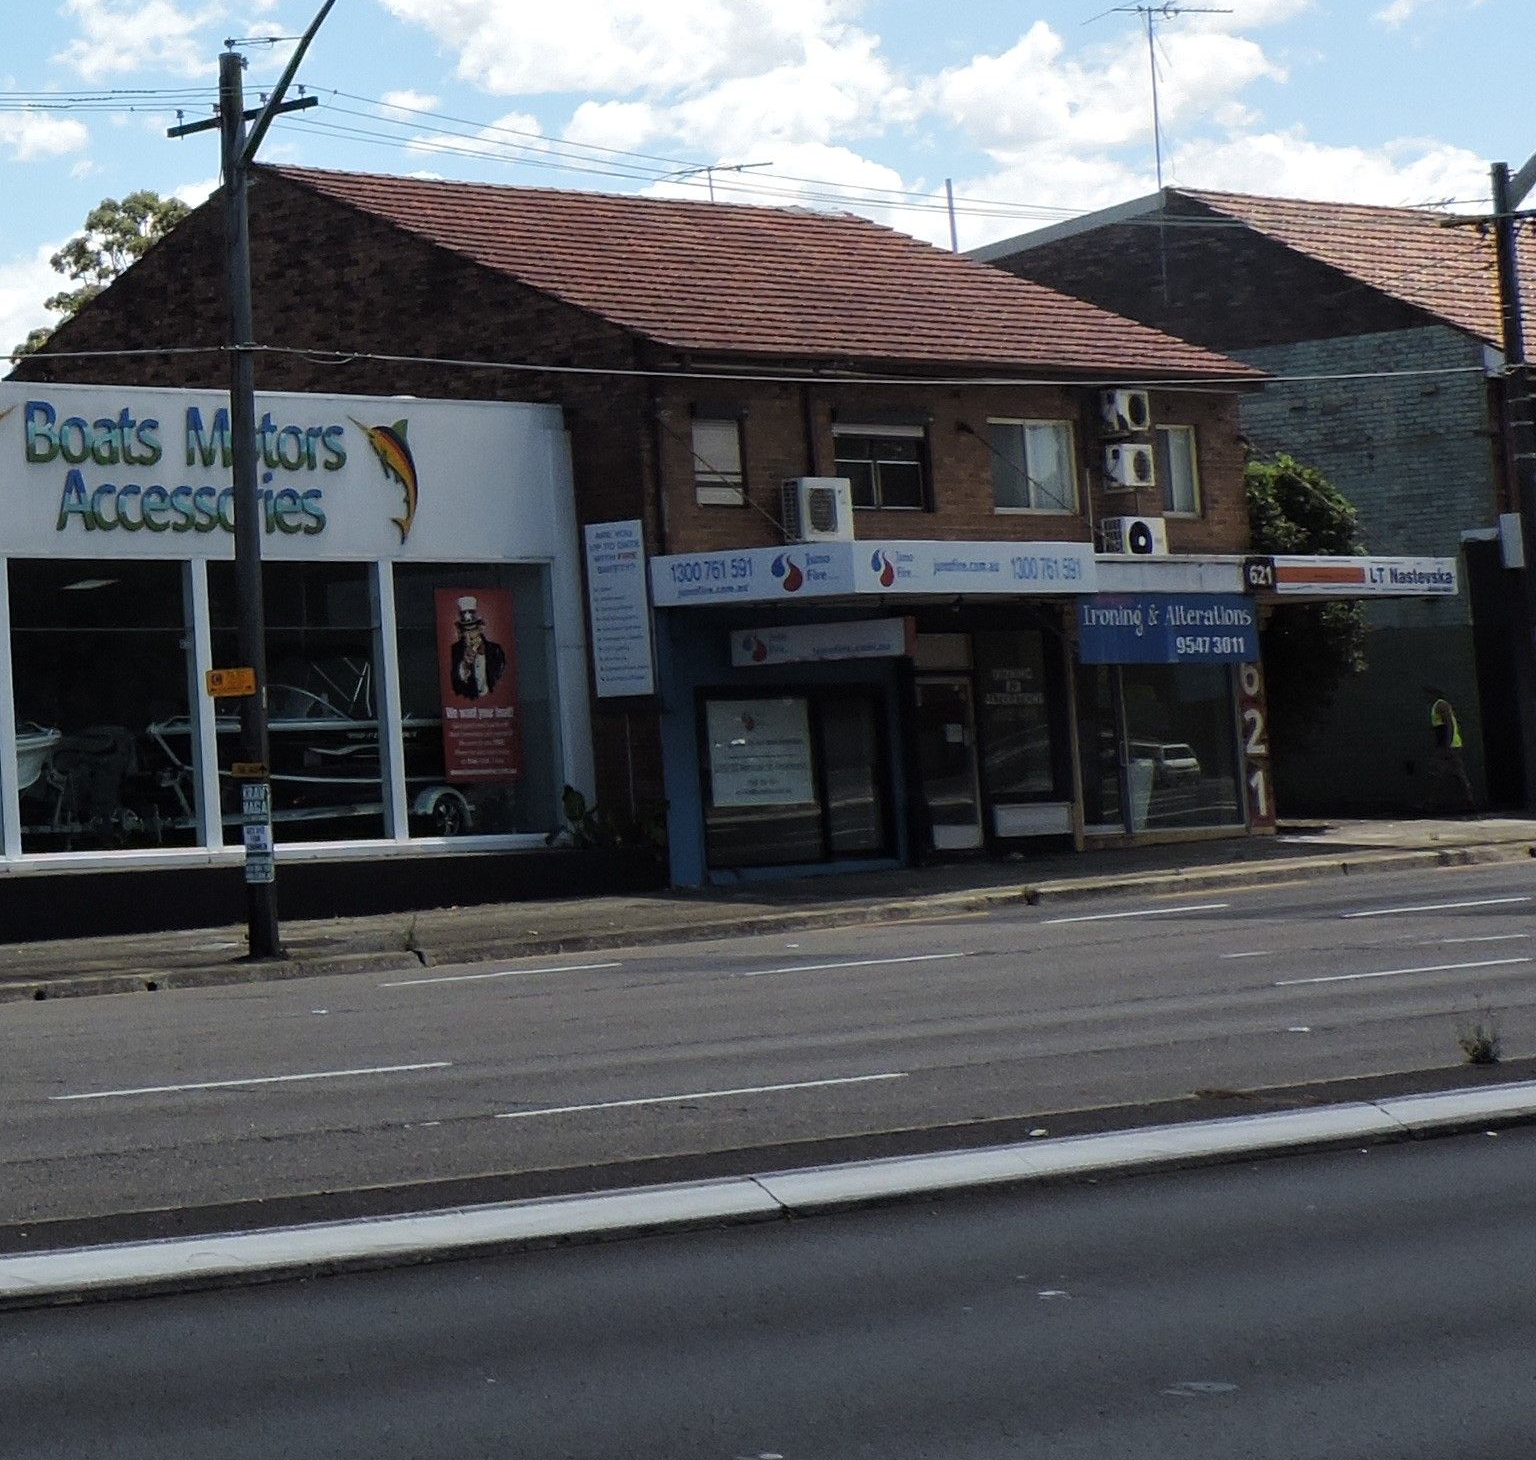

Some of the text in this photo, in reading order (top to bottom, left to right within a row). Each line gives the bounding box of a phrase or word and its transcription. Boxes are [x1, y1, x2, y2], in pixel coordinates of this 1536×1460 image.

[24, 400, 347, 471] Boats Mtors
[671, 557, 753, 583] 1300 761 591
[1011, 557, 1038, 581] 1300
[1040, 557, 1059, 580] 761
[1063, 557, 1082, 581] 591
[1249, 564, 1273, 585] 621
[1369, 568, 1385, 584] LT
[1083, 603, 1252, 637] Ironing & Alterations
[1176, 636, 1245, 654] 9547 3011
